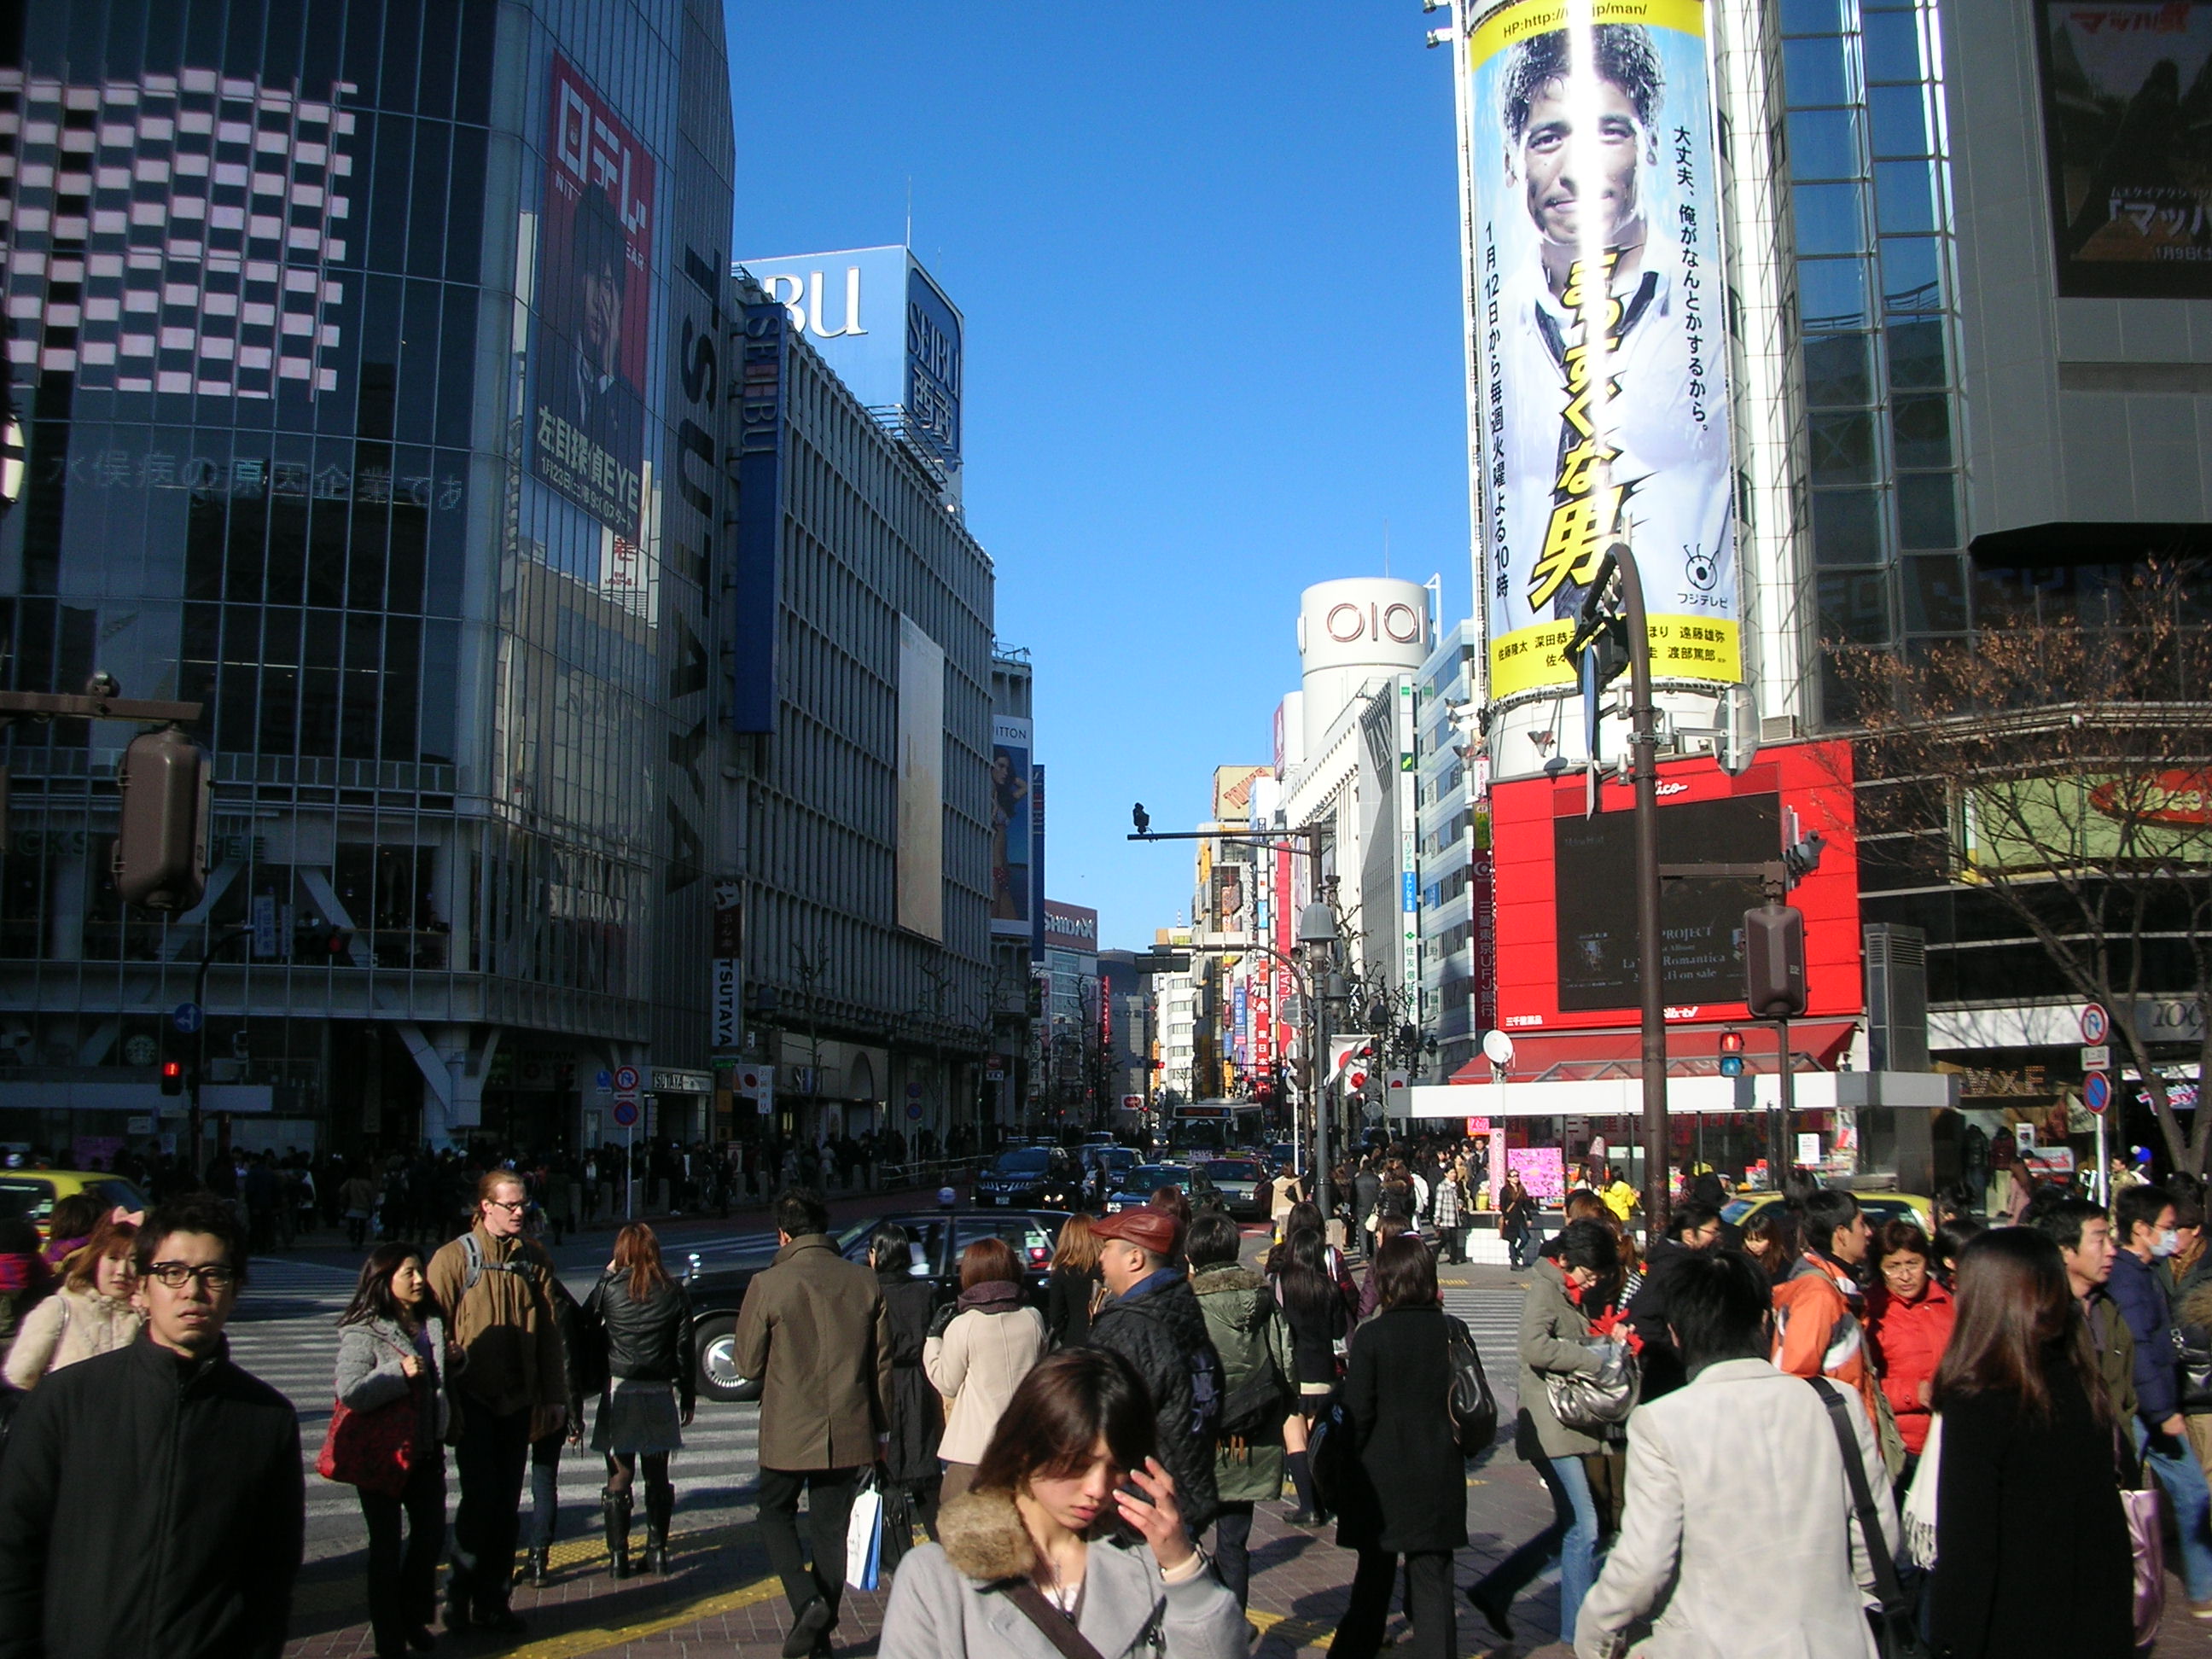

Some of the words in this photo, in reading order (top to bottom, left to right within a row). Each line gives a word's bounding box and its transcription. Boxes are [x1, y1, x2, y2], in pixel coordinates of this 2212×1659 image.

[740, 316, 781, 453] SEIBU
[906, 301, 960, 401] SEIBU
[1677, 593, 1729, 609] フジテレビ
[1654, 779, 1688, 796] ico
[718, 958, 734, 1047] TSUTAYA
[1478, 900, 1494, 1017] 三菱東京UFJ銀行
